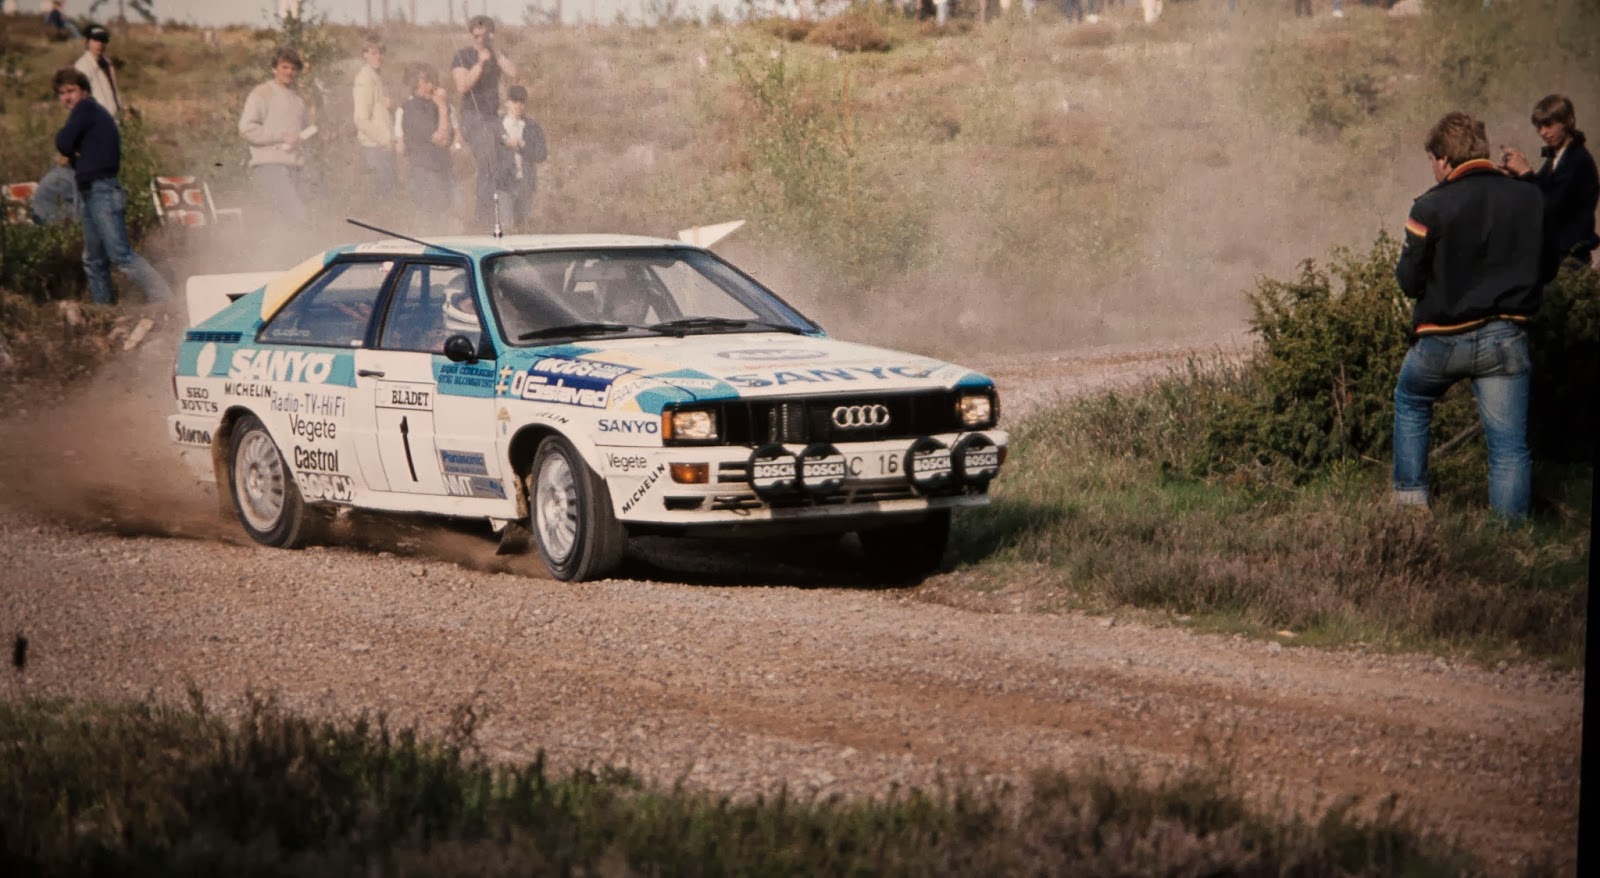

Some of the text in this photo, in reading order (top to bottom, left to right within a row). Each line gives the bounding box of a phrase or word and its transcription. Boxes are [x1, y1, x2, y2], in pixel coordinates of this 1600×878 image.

[228, 348, 336, 384] SANYO
[726, 365, 938, 388] SANYO
[224, 382, 274, 398] MICHELIN
[391, 390, 430, 407] BLADET
[289, 413, 337, 442] Vegete
[598, 418, 658, 434] SANYO
[294, 445, 339, 472] Castrol
[400, 415, 419, 483] 1
[606, 452, 647, 471] Vegete
[803, 463, 845, 477] BOSCH
[850, 454, 899, 476] C 16
[912, 455, 951, 471] BOSCH
[964, 453, 998, 467] BOSCH
[753, 464, 796, 478] BOSCH
[300, 474, 356, 501] BOSCH
[621, 463, 667, 514] MICHELIN
